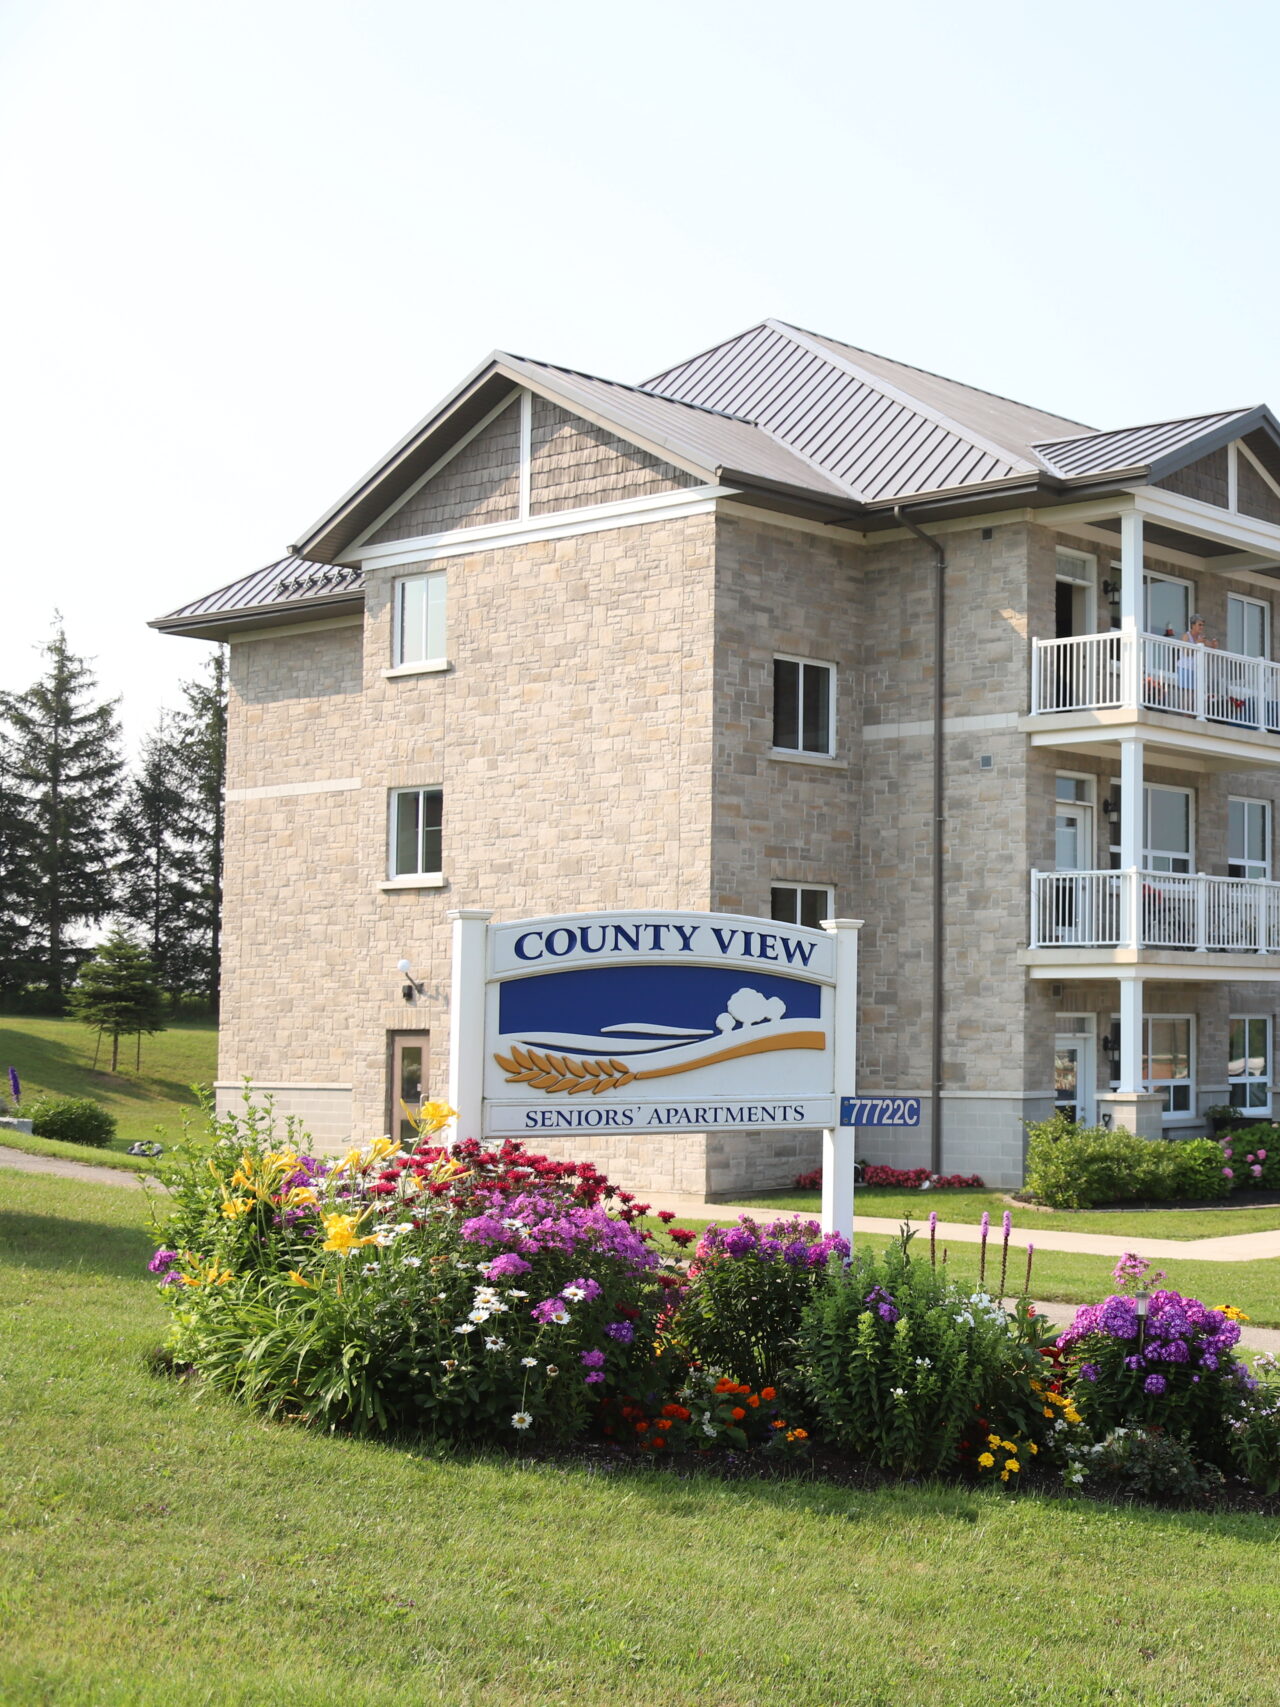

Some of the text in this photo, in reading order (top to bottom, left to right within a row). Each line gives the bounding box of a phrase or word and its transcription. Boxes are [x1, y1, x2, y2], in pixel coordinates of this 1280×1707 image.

[514, 923, 818, 967] COUNTY VIEW
[524, 1103, 805, 1129] SENIORS' APARTMENTS
[849, 1099, 918, 1125] 77722C
